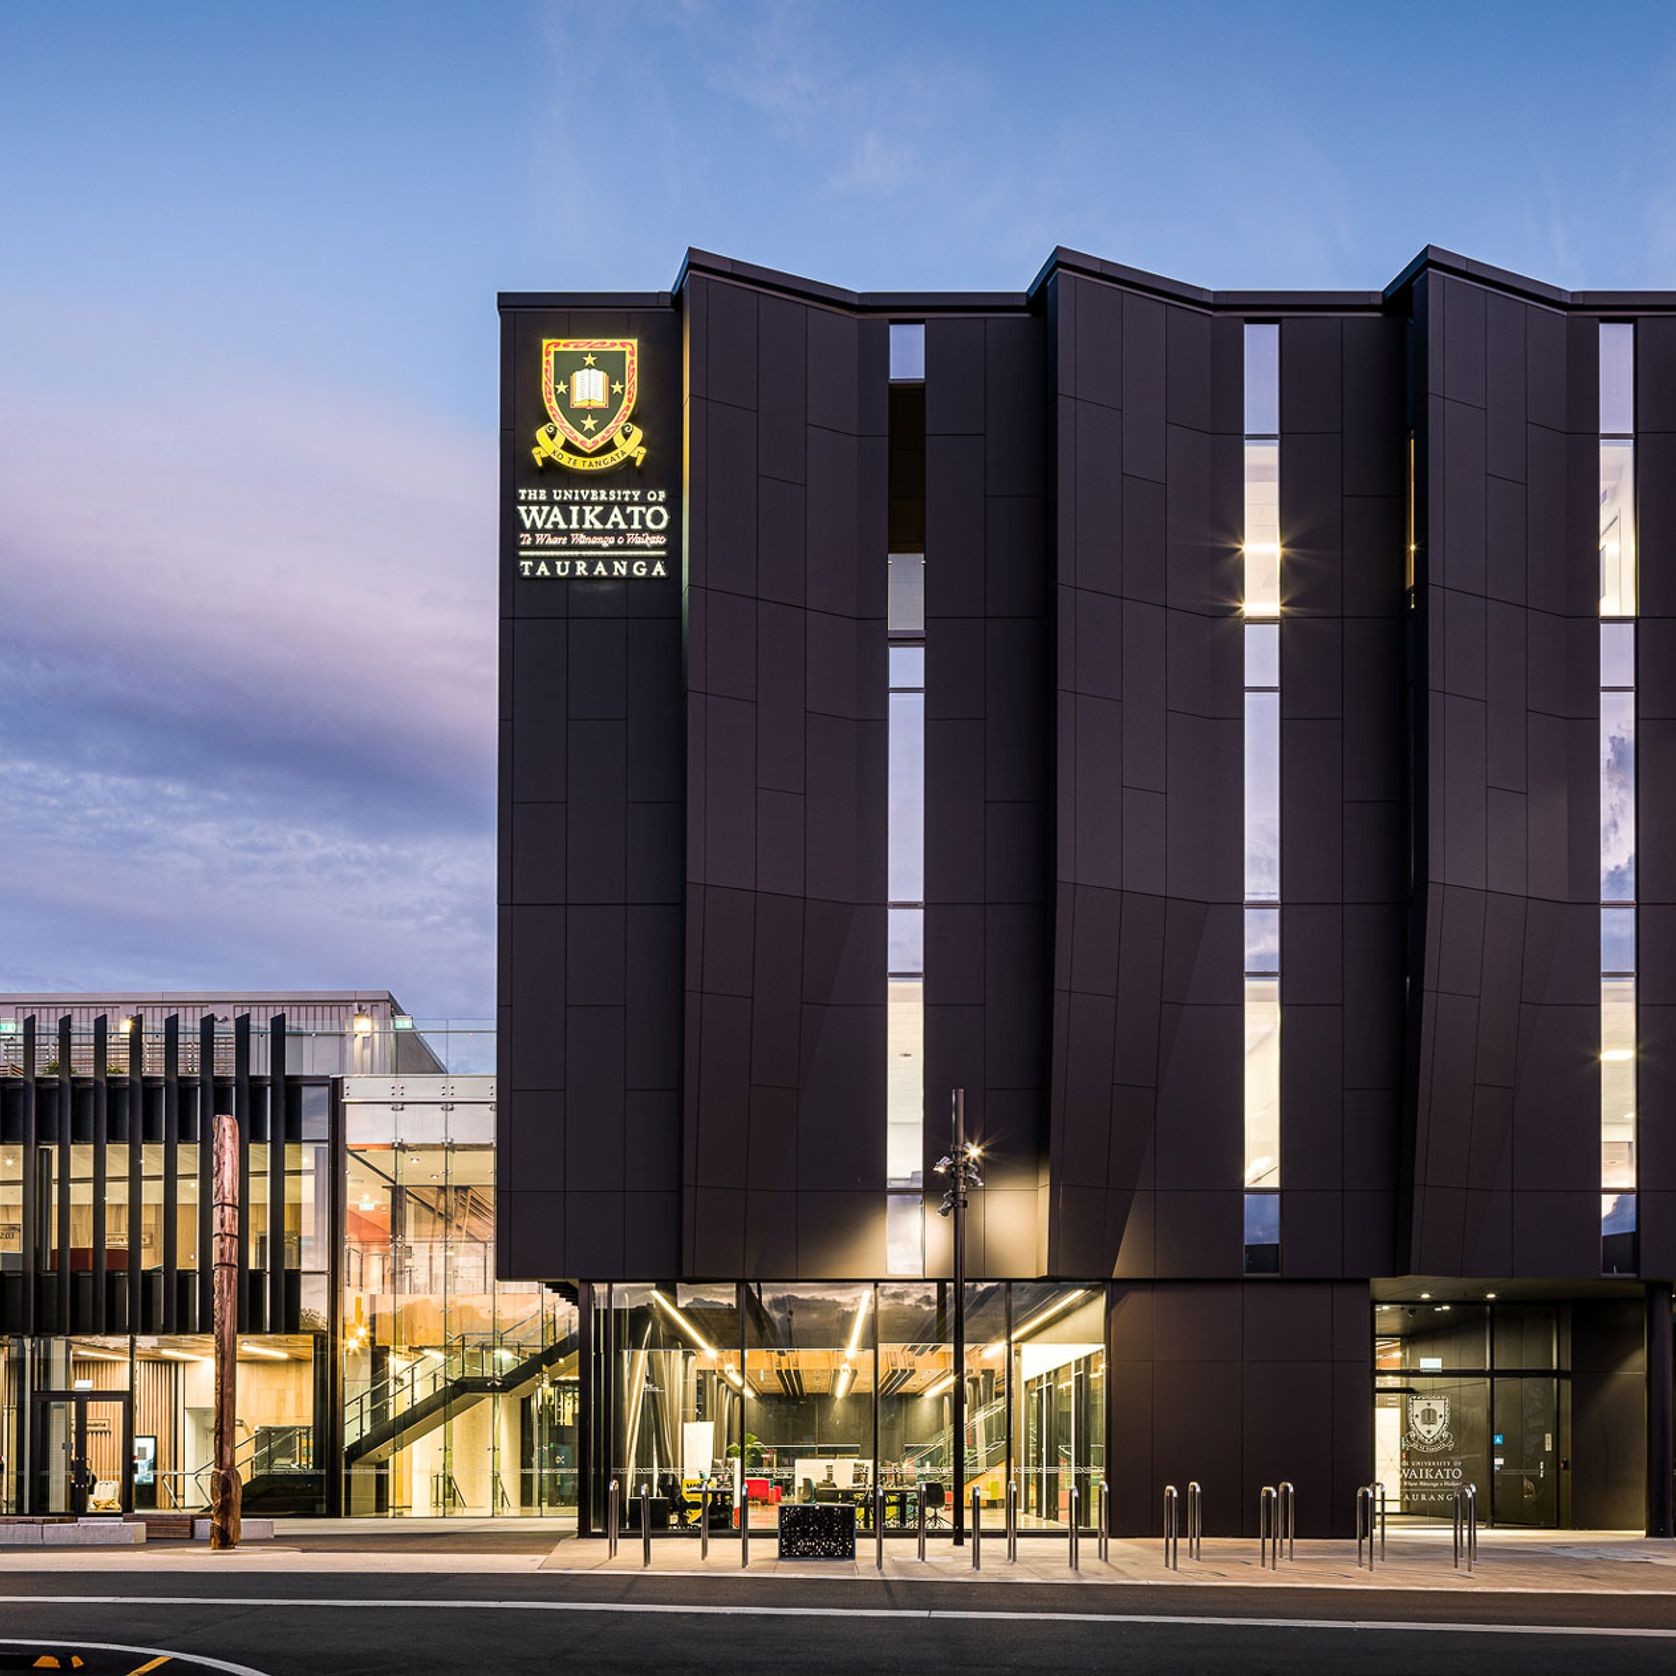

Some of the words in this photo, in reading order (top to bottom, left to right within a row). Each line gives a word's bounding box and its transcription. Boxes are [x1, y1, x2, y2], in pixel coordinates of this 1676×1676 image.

[551, 449, 564, 461] KO
[567, 457, 578, 467] TE
[581, 449, 627, 468] TANGATA
[518, 489, 547, 501] THE
[552, 489, 641, 501] UNIVERSITY
[647, 490, 666, 501] OF
[517, 505, 669, 530] WAIKATO
[625, 533, 666, 547] Waikato
[519, 560, 666, 576] TAURANGA
[1402, 1493, 1454, 1502] AURANG
